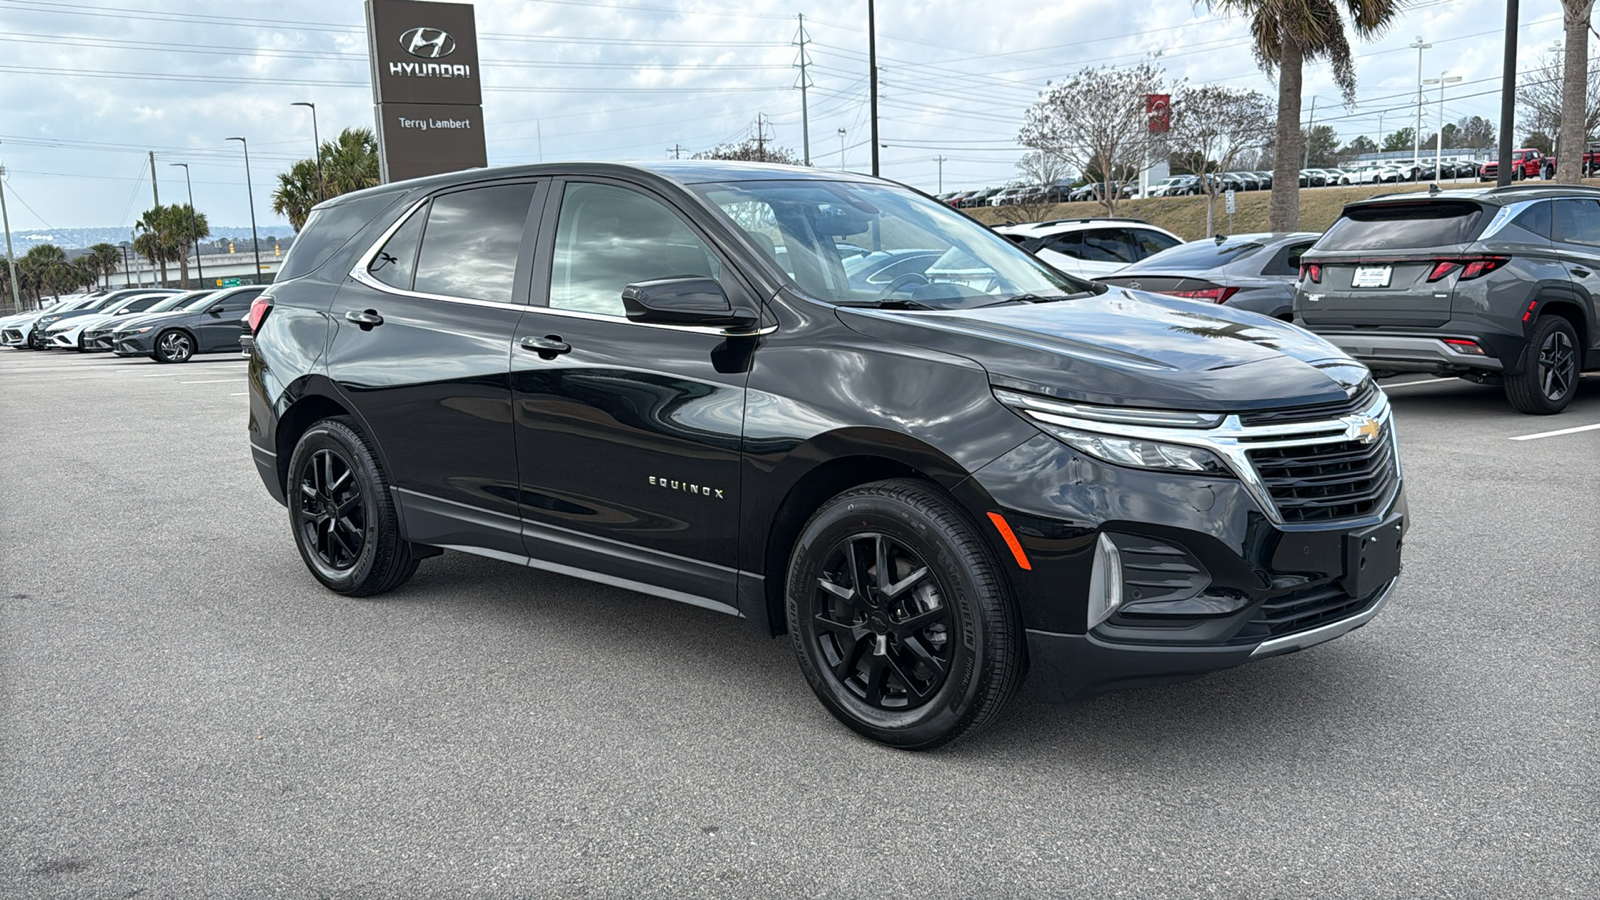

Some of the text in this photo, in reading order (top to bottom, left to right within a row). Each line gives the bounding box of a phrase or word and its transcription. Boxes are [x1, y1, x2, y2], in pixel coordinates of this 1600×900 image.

[389, 62, 471, 78] HYUNDAI
[398, 117, 471, 130] Terry Lambert
[648, 475, 724, 499] EQUINOX
[950, 572, 974, 646] MICHELIN
[789, 601, 809, 667] MICHELIN
